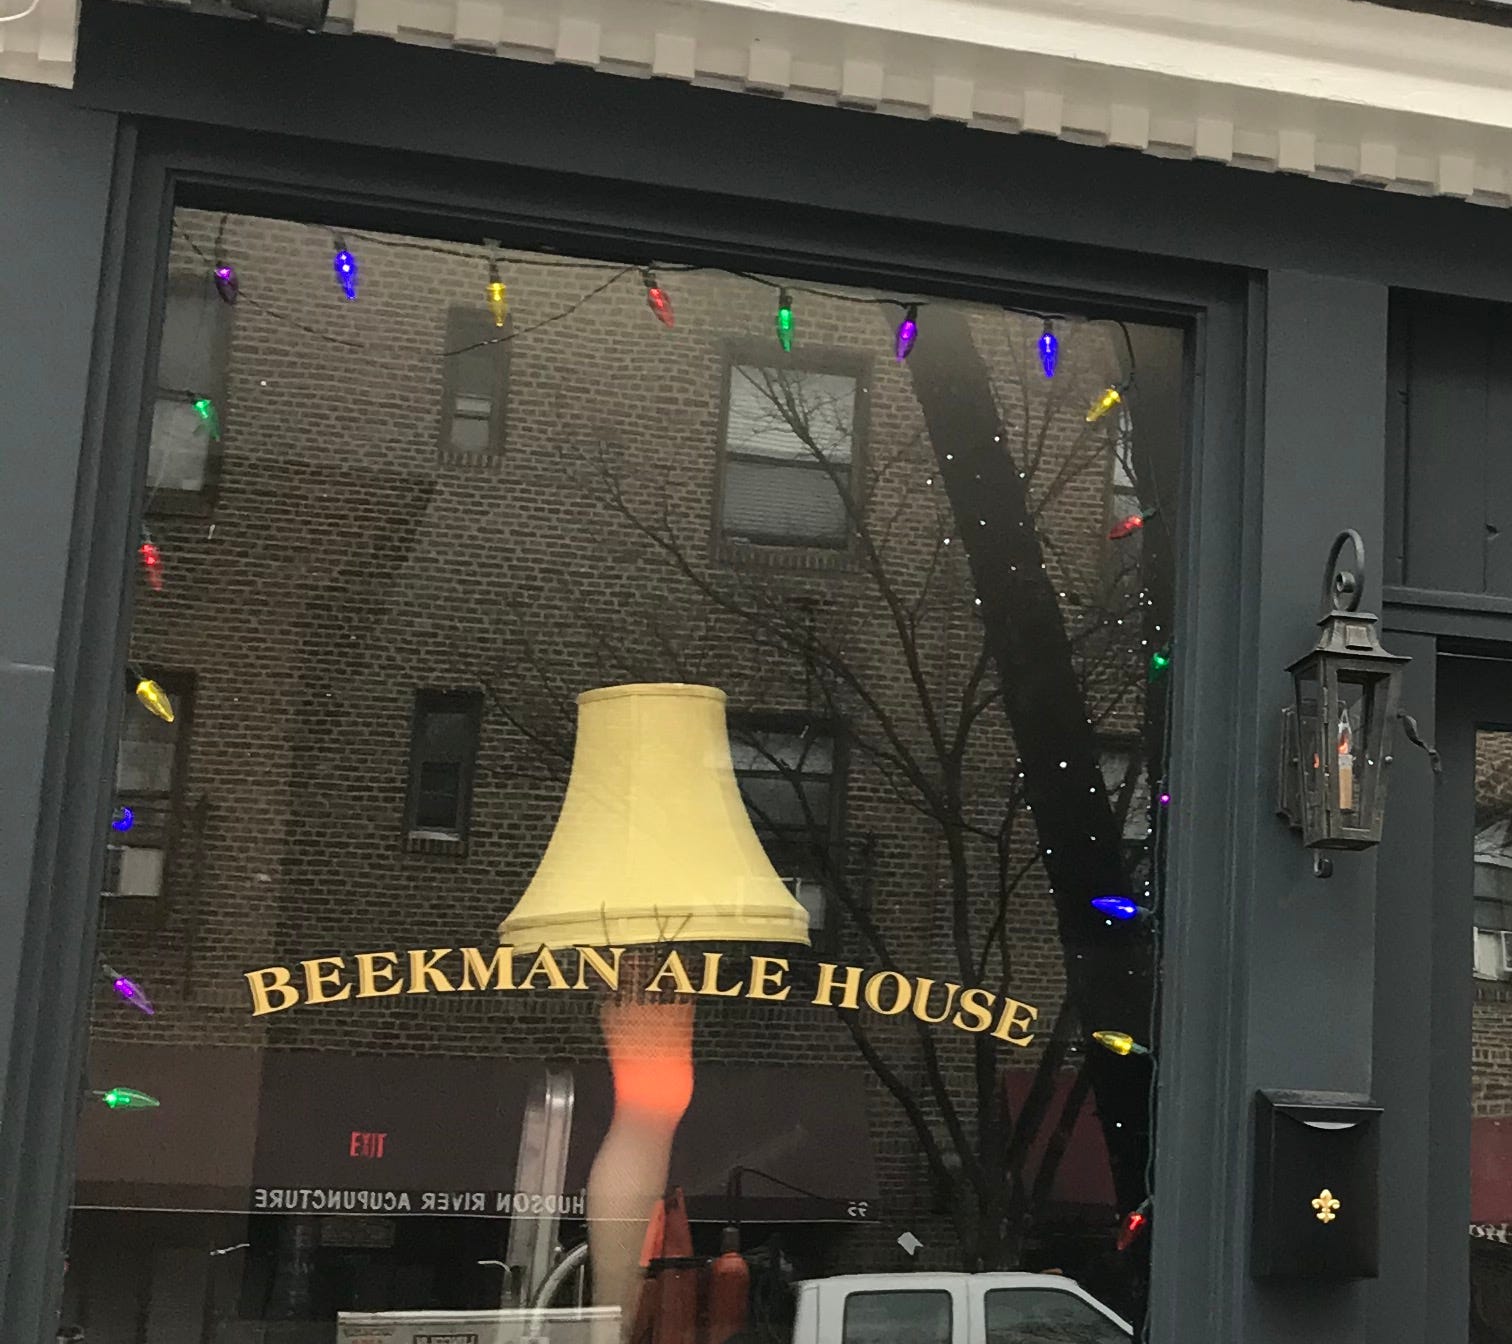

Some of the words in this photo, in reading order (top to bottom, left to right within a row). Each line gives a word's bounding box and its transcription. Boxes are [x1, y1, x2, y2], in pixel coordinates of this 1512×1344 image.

[244, 945, 626, 1018] BEEKMAN
[646, 950, 791, 1002] ALE
[812, 965, 1039, 1047] HOUSE
[349, 1131, 388, 1158] EXIT
